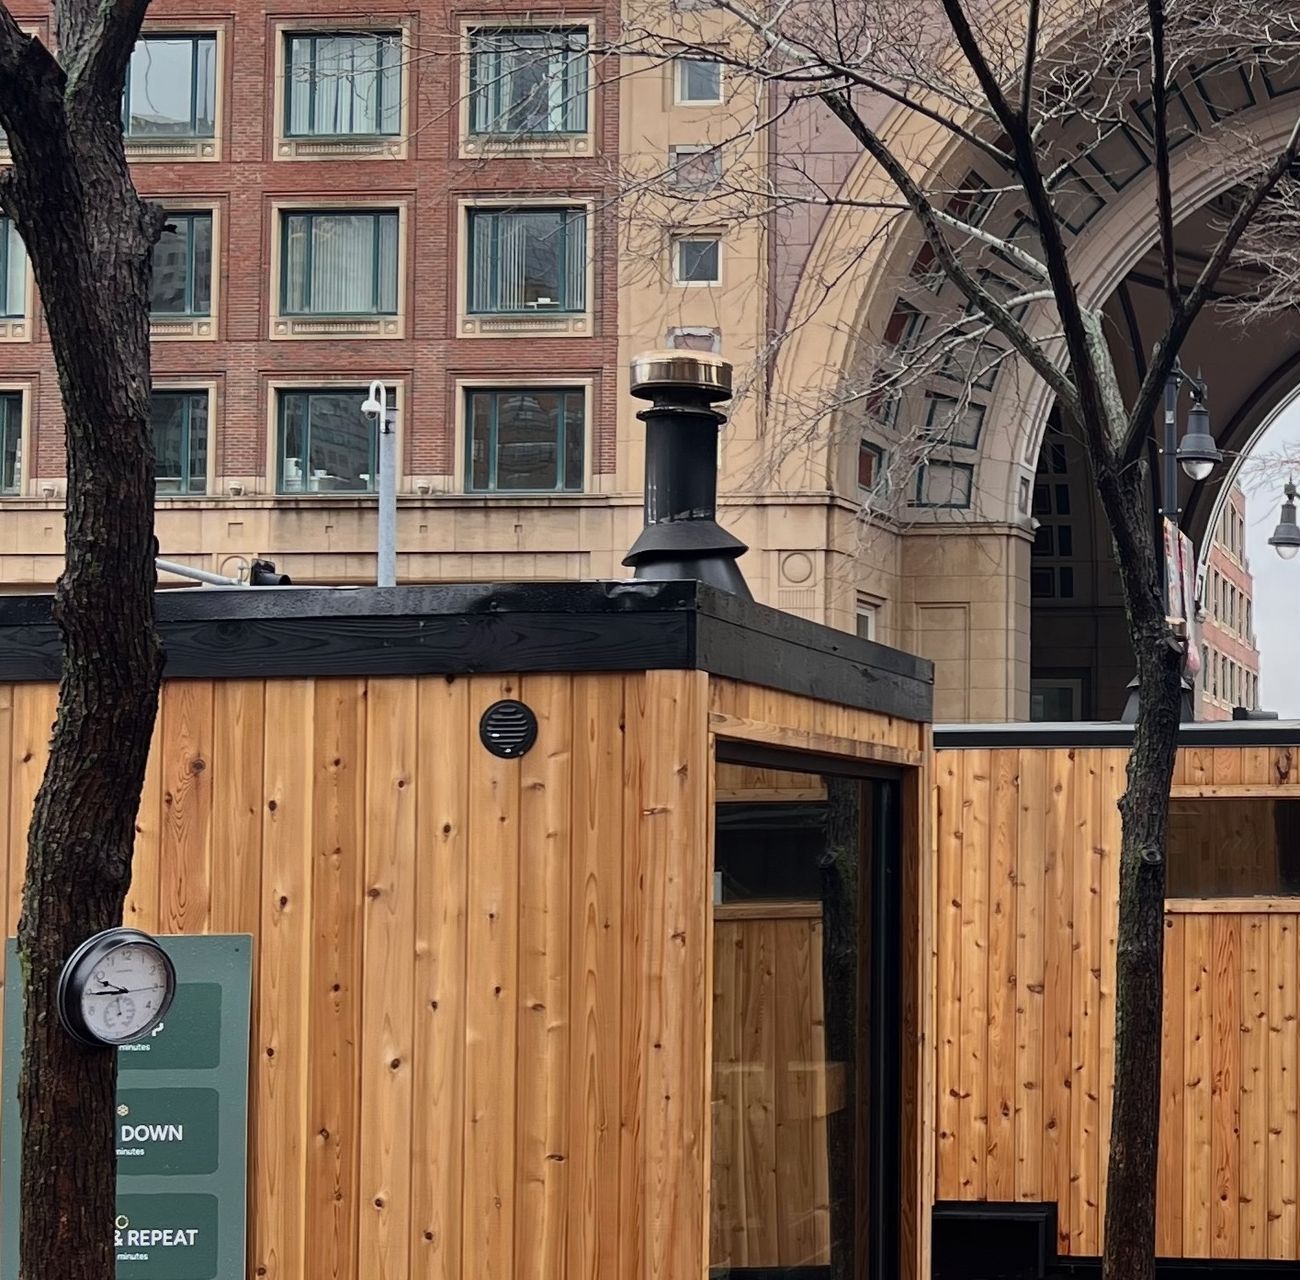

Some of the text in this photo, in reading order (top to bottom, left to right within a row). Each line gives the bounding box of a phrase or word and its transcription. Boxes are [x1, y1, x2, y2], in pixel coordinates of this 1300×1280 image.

[121, 1125, 183, 1142] DOWN
[127, 1229, 199, 1247] REPEAT
[117, 1253, 149, 1261] minutes
